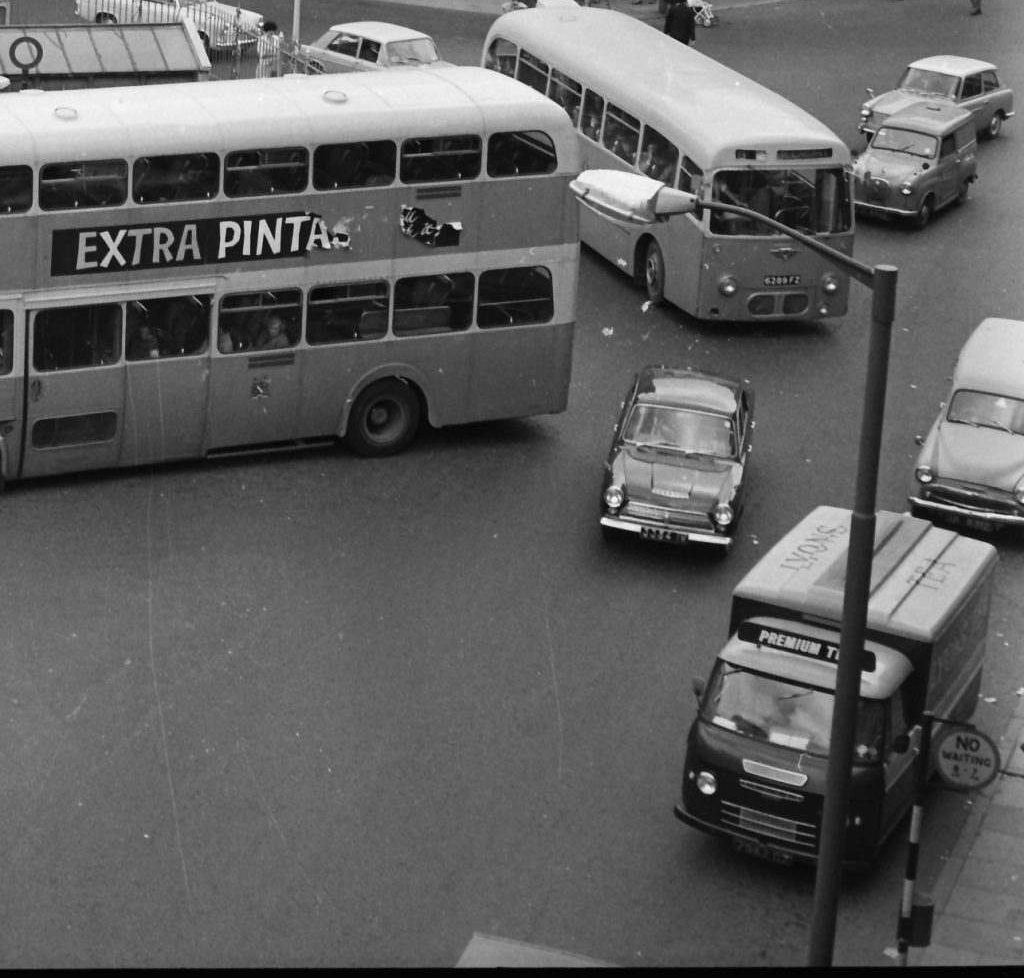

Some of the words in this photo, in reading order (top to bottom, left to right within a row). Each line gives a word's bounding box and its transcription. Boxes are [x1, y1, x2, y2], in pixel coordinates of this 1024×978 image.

[76, 224, 202, 271] EXTRA
[758, 629, 822, 656] PREMIUM
[955, 734, 981, 752] NO
[942, 749, 992, 768] WAITING
